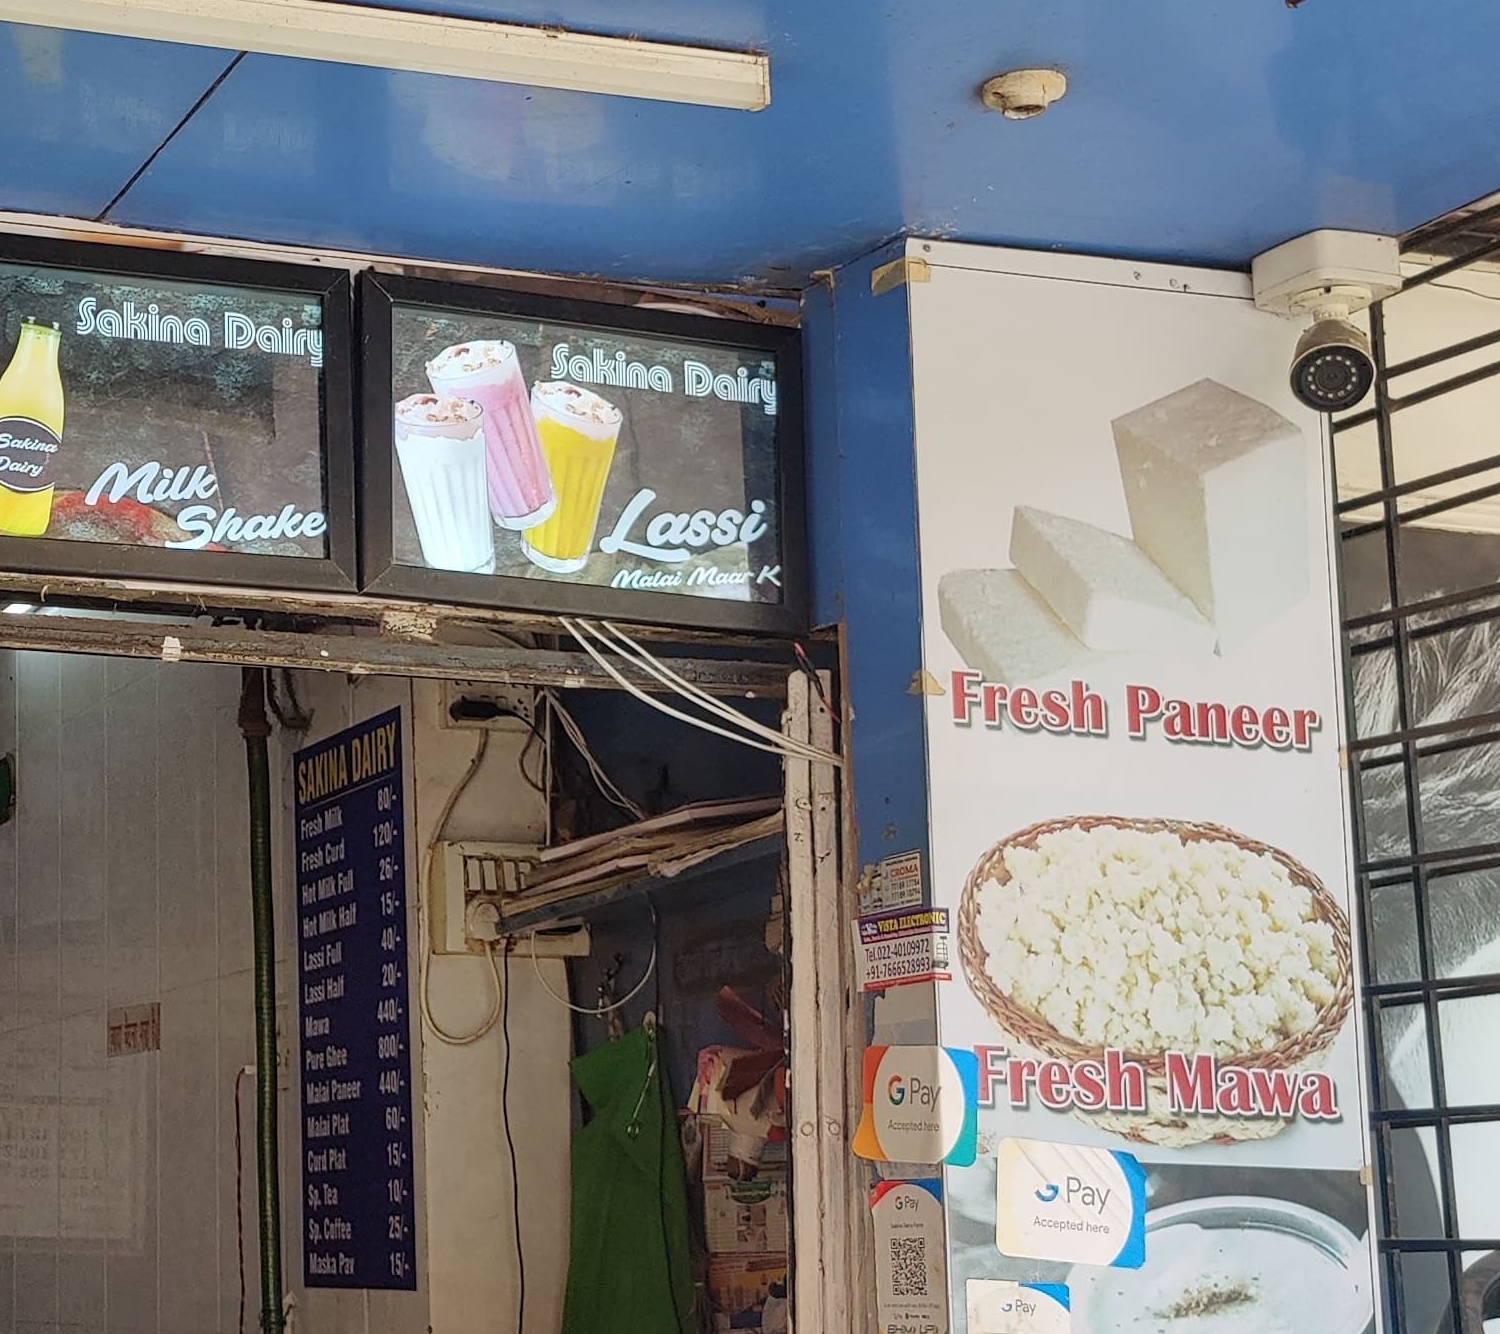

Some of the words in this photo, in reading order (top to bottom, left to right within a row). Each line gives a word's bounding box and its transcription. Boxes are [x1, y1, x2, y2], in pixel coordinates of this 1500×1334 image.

[76, 296, 210, 346] Sakina
[224, 312, 323, 368] Dairy
[550, 343, 672, 393] Sakina
[684, 359, 777, 415] Dairy
[85, 461, 219, 507] Milk
[165, 504, 327, 551] Shake
[600, 488, 768, 562] Lassi
[611, 569, 682, 588] Malai
[687, 567, 753, 585] Maar
[950, 669, 1108, 737] Fresh
[1126, 683, 1322, 750] Paneer
[299, 744, 348, 804] SAKINA
[352, 722, 396, 783] DAIRY
[301, 817, 322, 840] Fresh
[324, 806, 343, 832] Milk
[302, 849, 323, 872] Fresh
[325, 839, 345, 864] Curd
[302, 883, 316, 905] Hot
[318, 876, 336, 901] Milk
[338, 870, 353, 894] Full
[303, 916, 316, 939] Hot
[318, 910, 337, 935] Milk
[339, 903, 357, 928] Half
[899, 911, 947, 930] ELECTRONIC
[304, 946, 325, 971] Lassi
[326, 941, 342, 966] Full
[304, 981, 325, 1004] Lassi
[327, 975, 345, 999] Half
[305, 1017, 330, 1038] Mawa
[306, 1050, 324, 1071] Pure
[326, 1045, 348, 1067] Ghee
[307, 1082, 329, 1104] Malai
[331, 1079, 361, 1101] Paneer
[909, 1077, 942, 1113] Pay
[973, 1043, 1148, 1112] Fresh
[1164, 1050, 1340, 1121] Mawa
[307, 1116, 330, 1137] Malai
[307, 1150, 327, 1172] Curd
[308, 1185, 322, 1207] Sp.
[323, 1184, 338, 1205] Tea
[905, 1196, 919, 1211] Pay
[1067, 1175, 1110, 1214] Pay
[308, 1220, 322, 1244] Sp.
[323, 1218, 352, 1240] Coffee
[1034, 1215, 1082, 1233] Accepted
[1085, 1221, 1110, 1234] here
[309, 1253, 337, 1275] Maska
[338, 1252, 355, 1275] Pav
[1015, 1299, 1036, 1316] Pay
